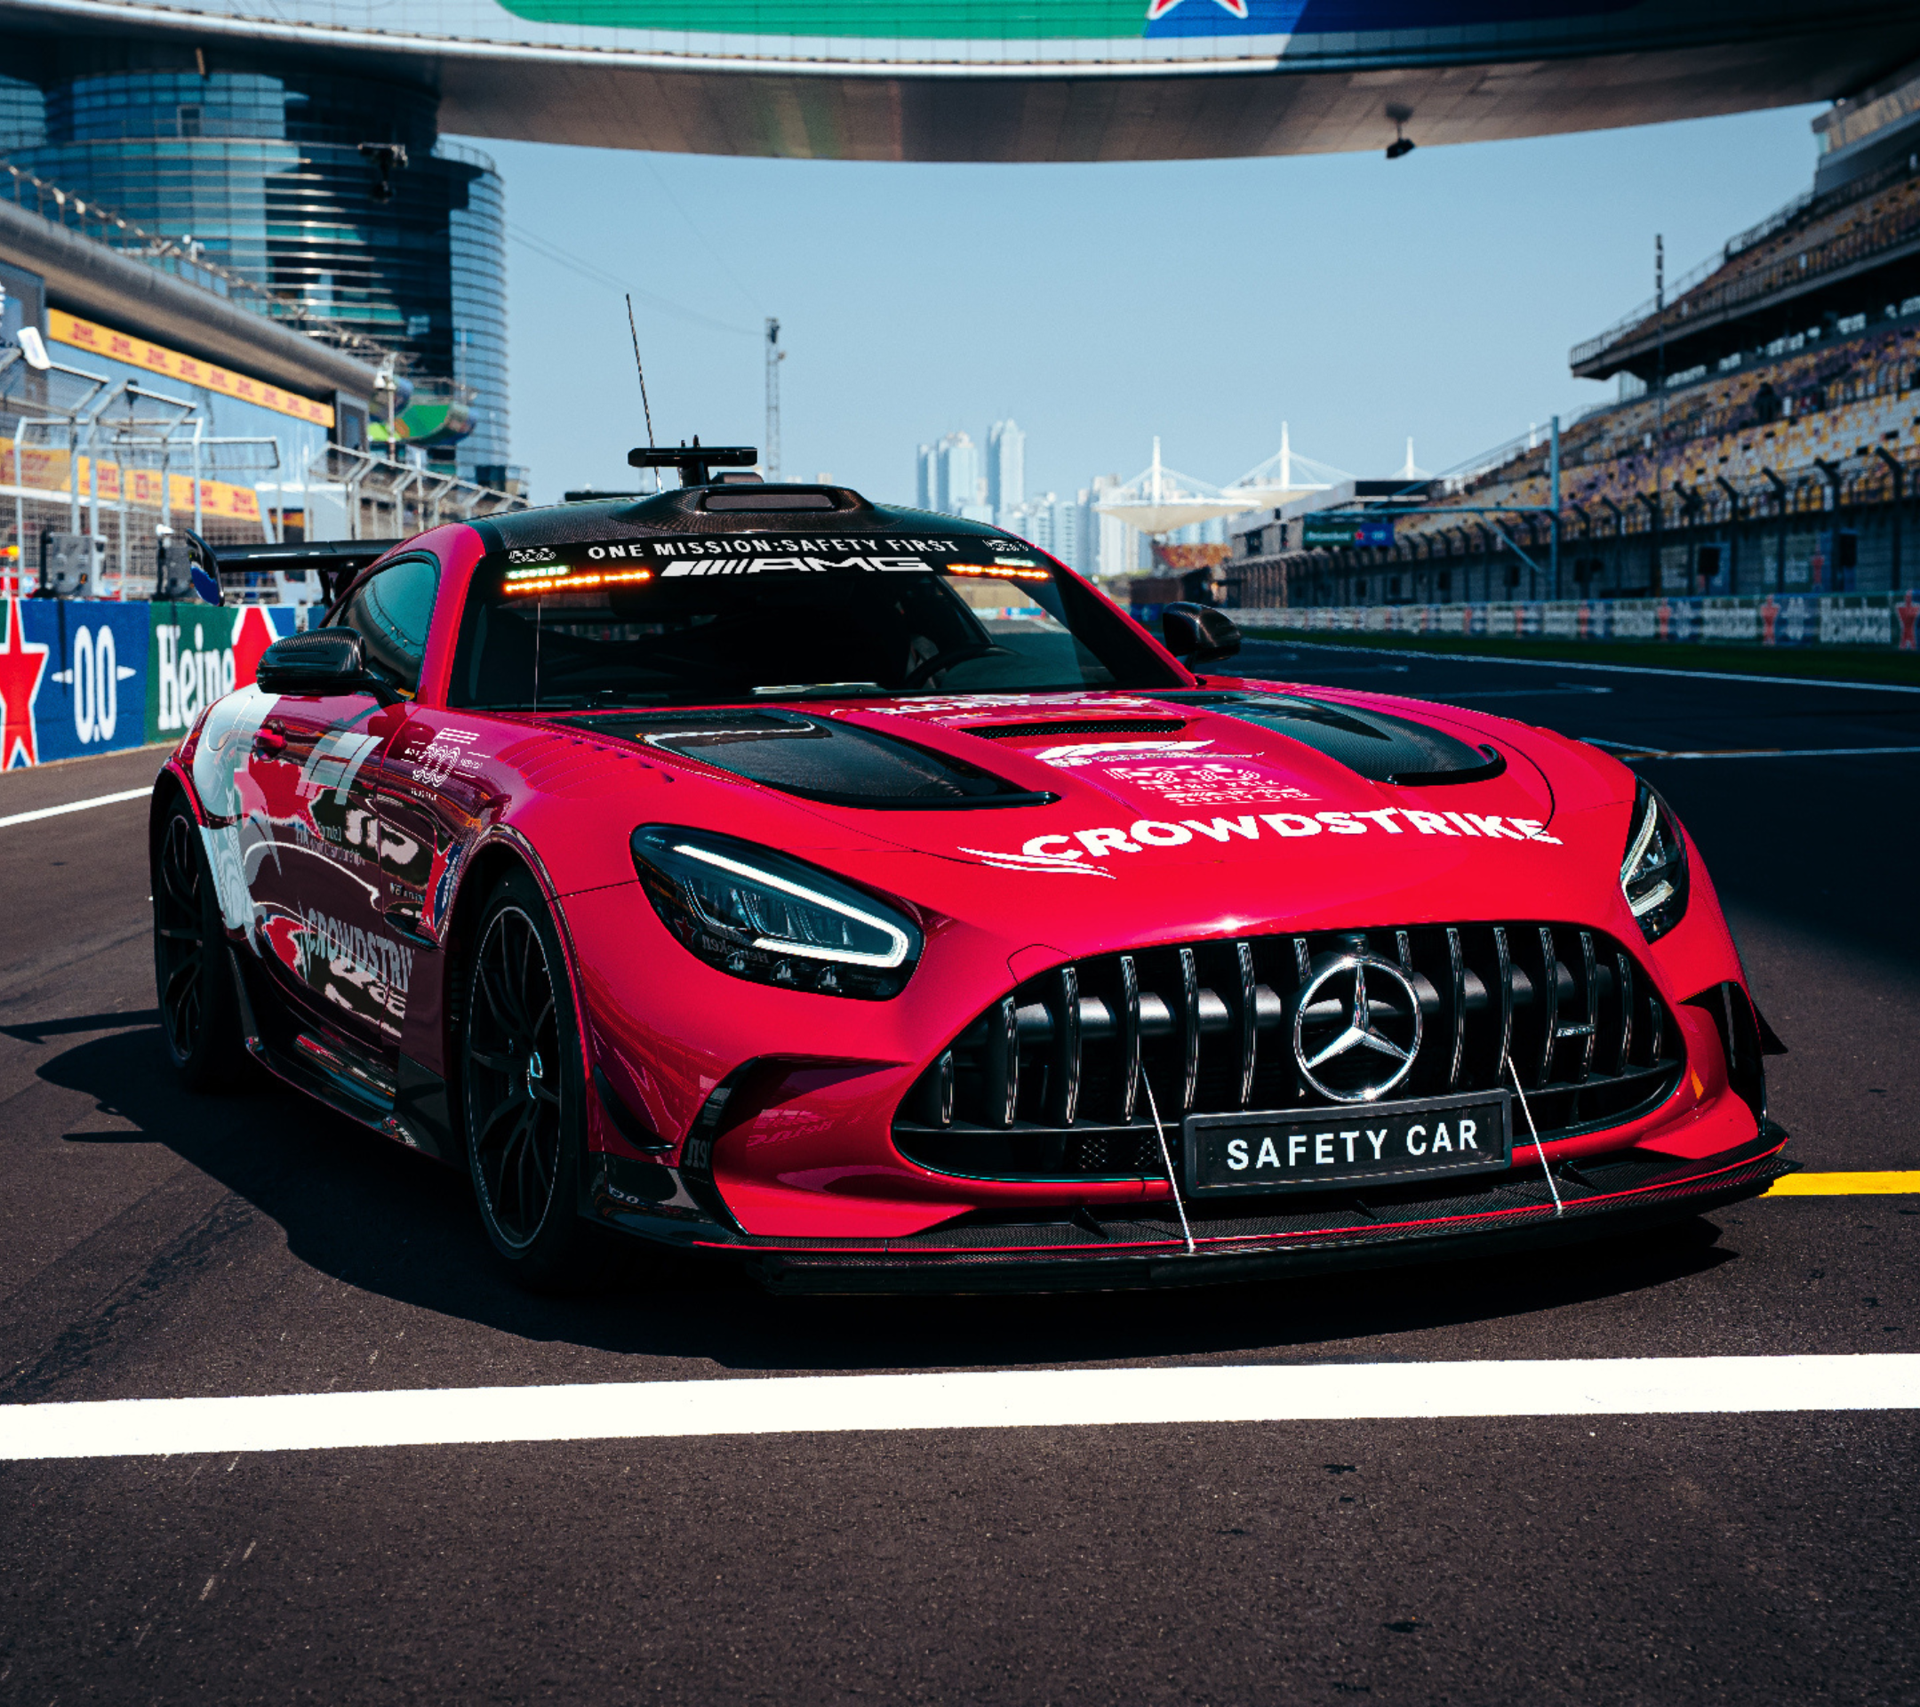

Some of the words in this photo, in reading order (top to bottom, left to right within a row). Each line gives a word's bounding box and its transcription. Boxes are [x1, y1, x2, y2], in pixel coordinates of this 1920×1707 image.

[588, 543, 644, 560] ONE
[885, 539, 960, 551] FIRST
[747, 556, 934, 574] AMG
[1022, 806, 1563, 860] CROWDSTRIKE
[1227, 1128, 1388, 1170] SAFETY
[1406, 1119, 1478, 1156] CAR
